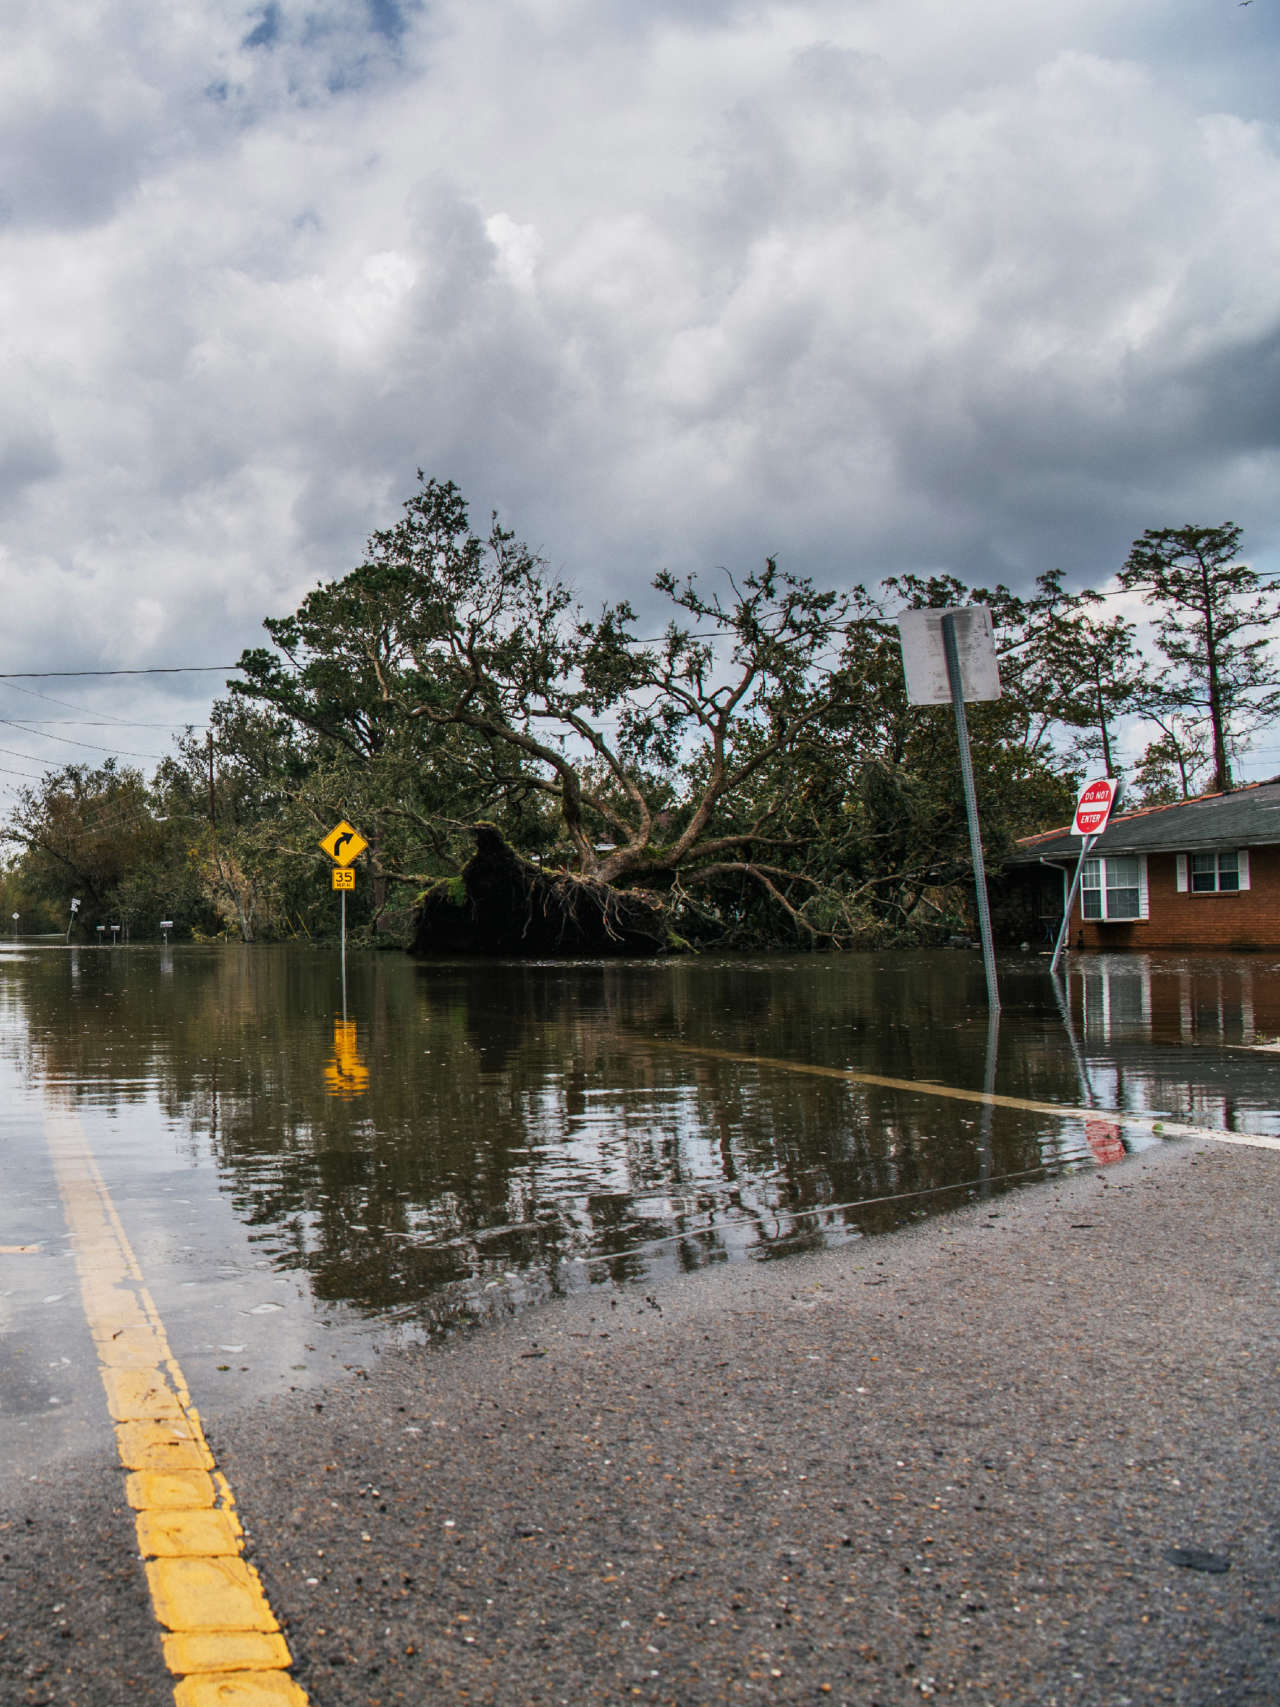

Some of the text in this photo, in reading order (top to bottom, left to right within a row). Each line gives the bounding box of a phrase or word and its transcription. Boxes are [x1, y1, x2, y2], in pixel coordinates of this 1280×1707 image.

[1085, 790, 1109, 800] DO NOT
[1081, 814, 1100, 823] ENTER
[336, 872, 352, 882] 35
